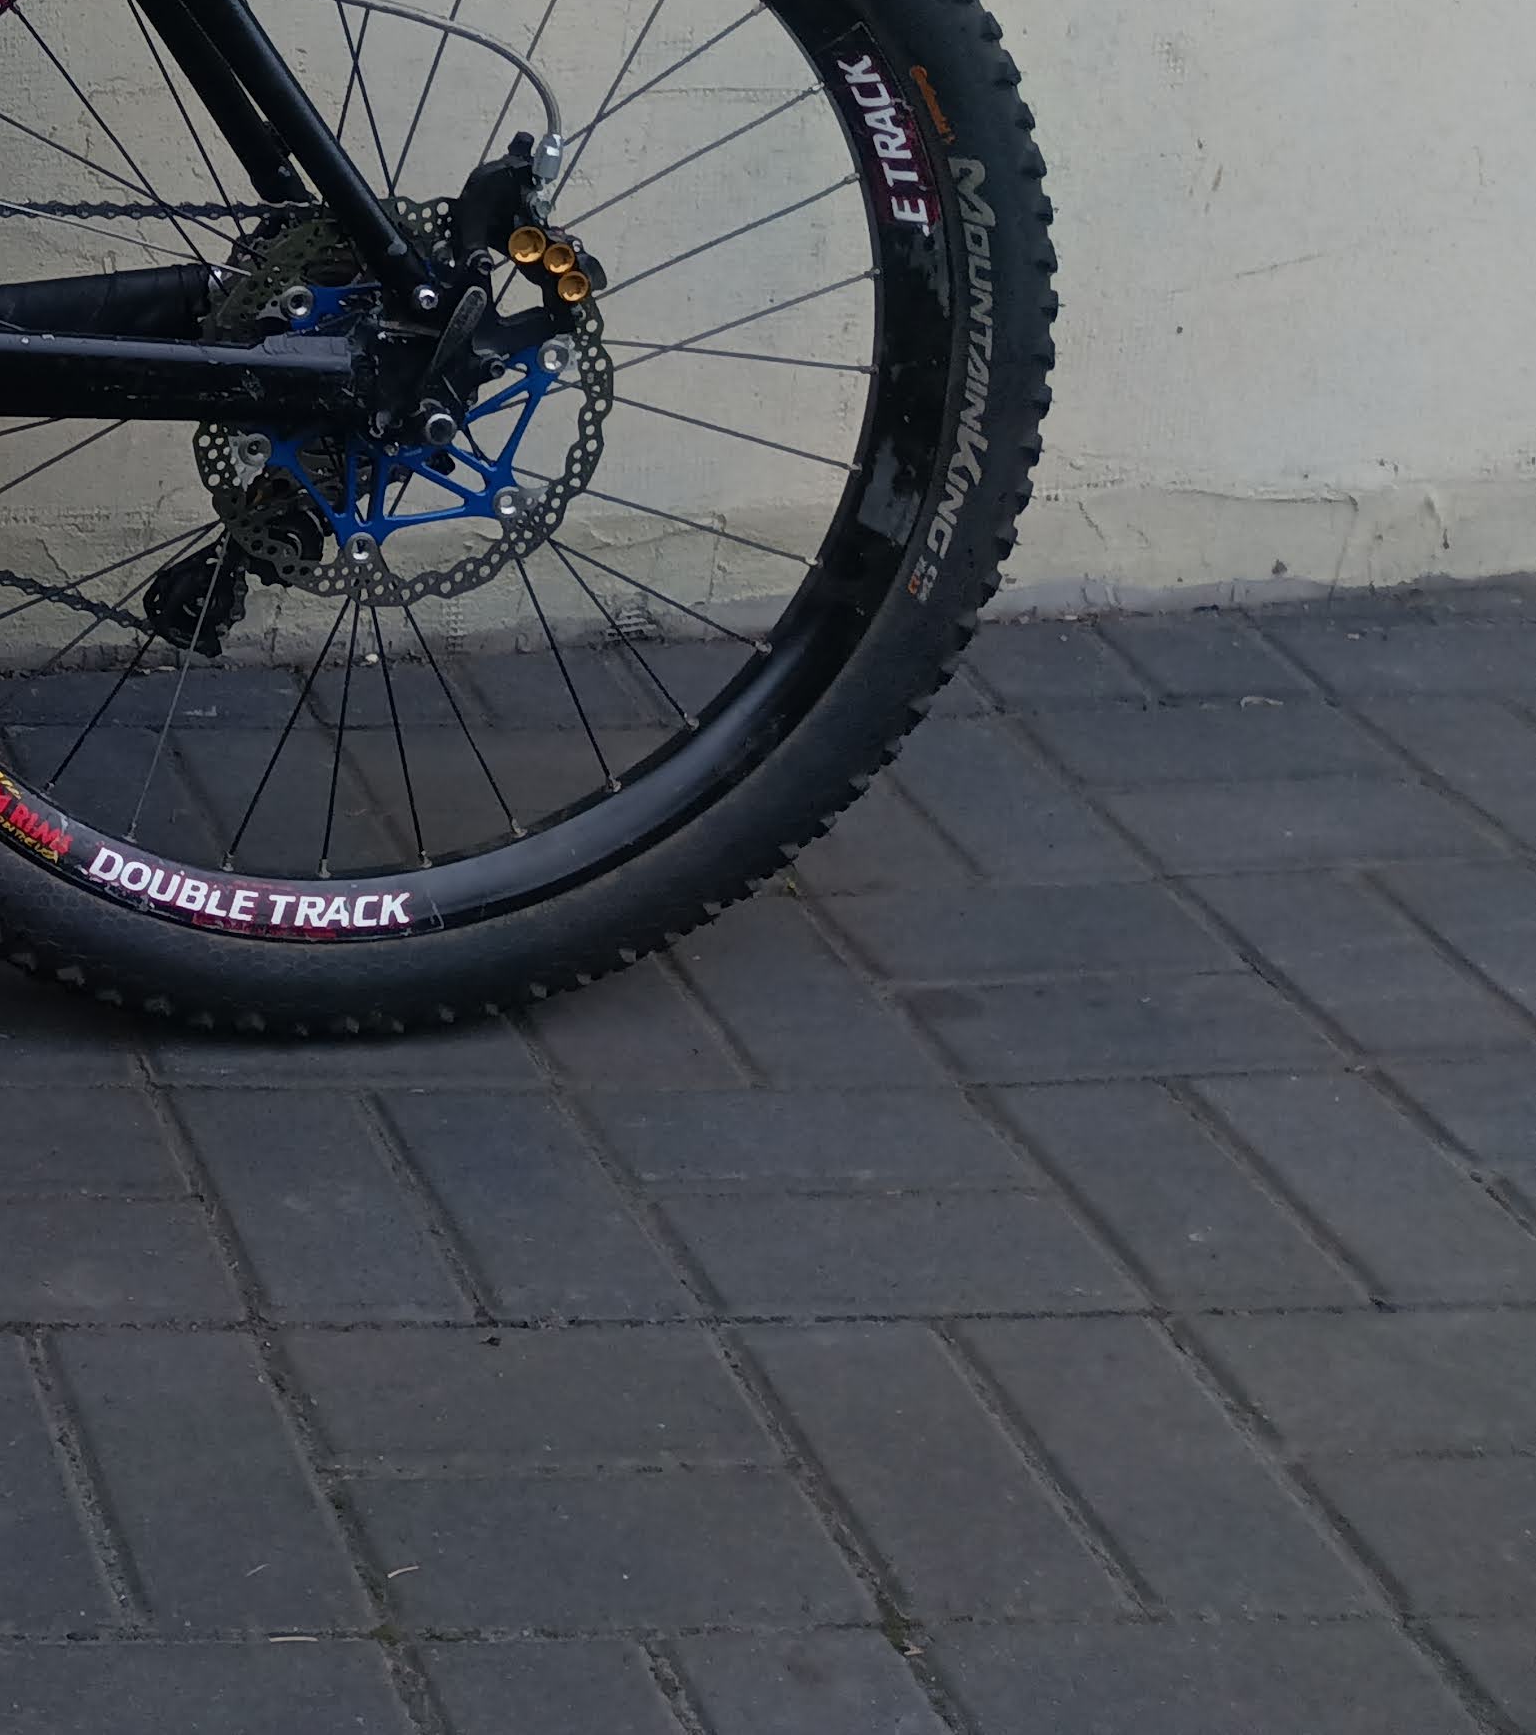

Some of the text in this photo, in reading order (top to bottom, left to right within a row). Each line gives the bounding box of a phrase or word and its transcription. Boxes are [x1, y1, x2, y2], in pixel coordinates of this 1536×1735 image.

[836, 55, 920, 191] TRACK
[89, 848, 411, 928] DOUBLE TRACK
